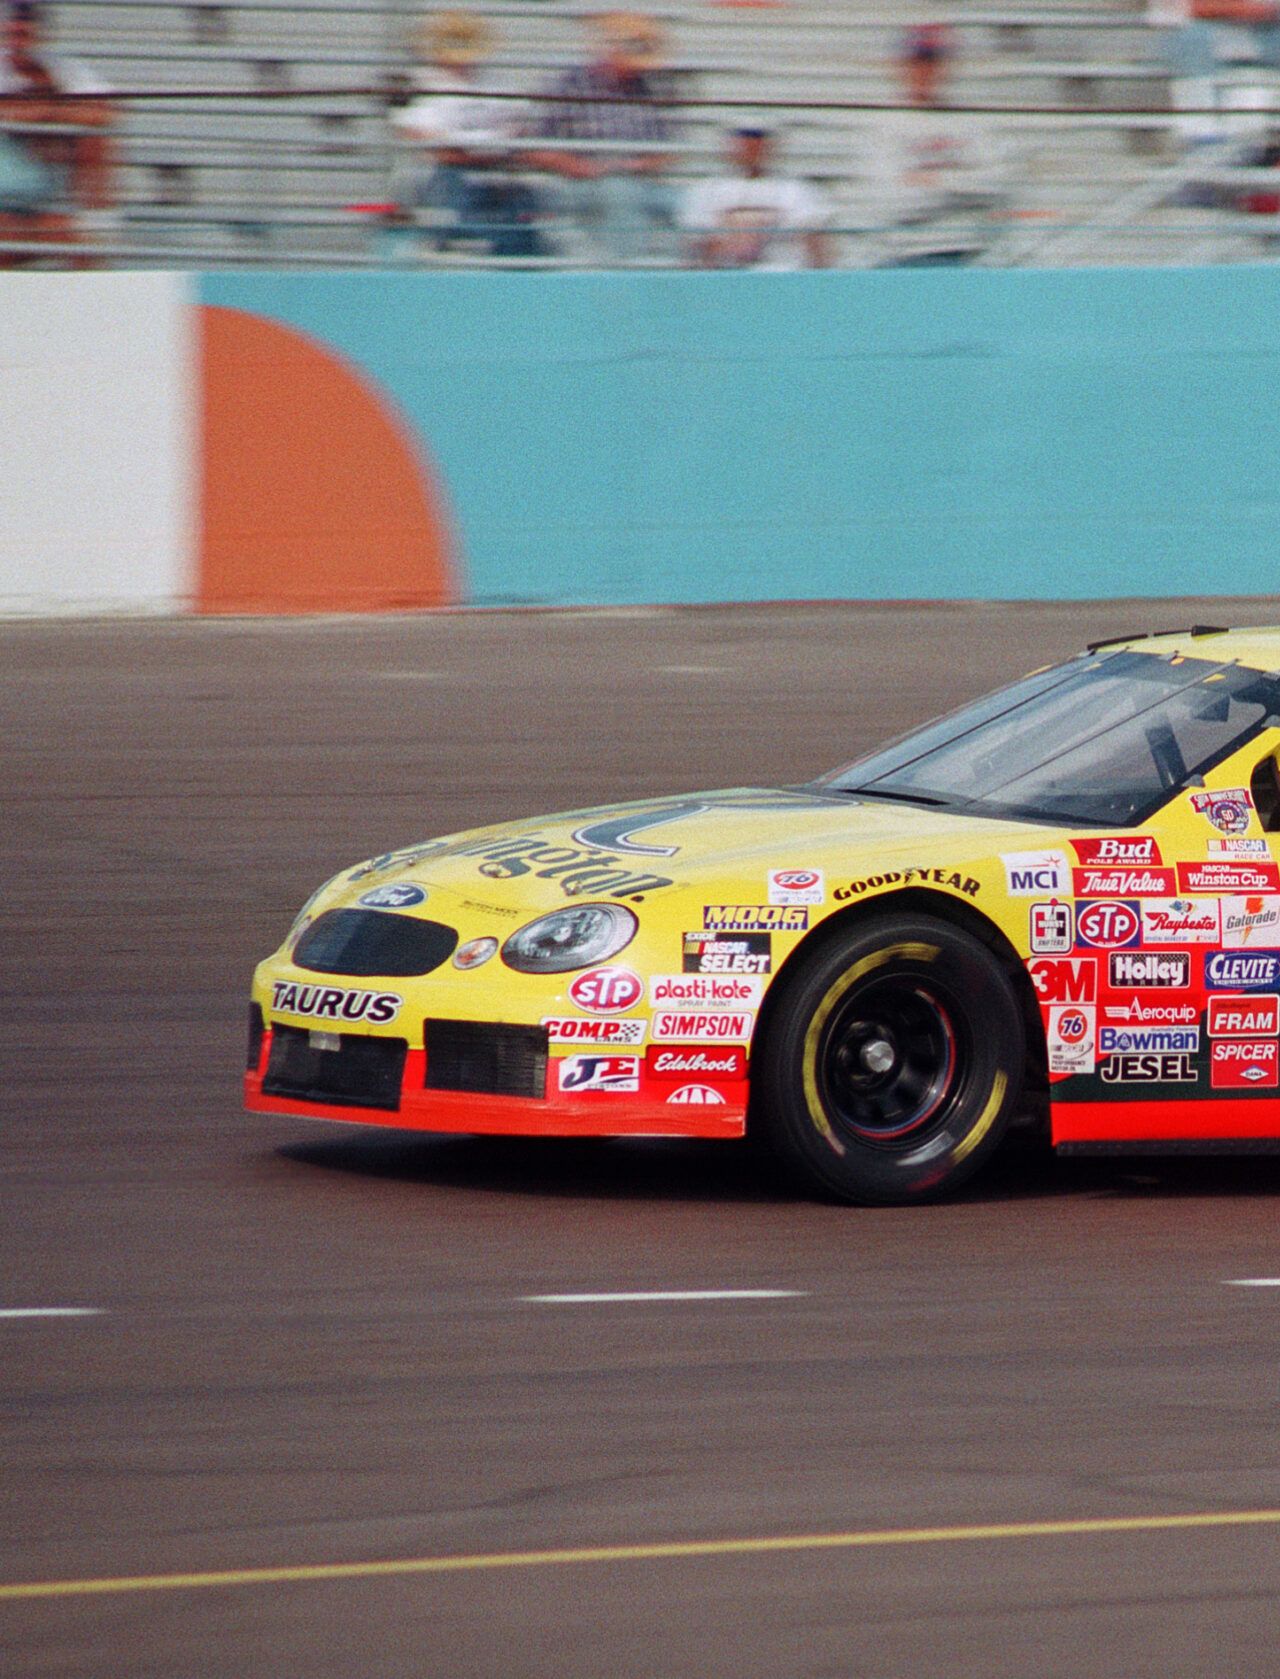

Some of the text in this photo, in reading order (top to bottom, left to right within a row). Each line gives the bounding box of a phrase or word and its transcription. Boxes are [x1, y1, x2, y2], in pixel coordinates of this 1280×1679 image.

[1097, 839, 1153, 858] Bud
[1226, 839, 1265, 852] NASCAR
[1201, 865, 1231, 873] NASCAR
[832, 868, 982, 898] GOODYEAR
[1010, 870, 1059, 890] MCI
[1187, 872, 1269, 887] Winston Cup
[705, 906, 807, 923] MOOG
[1085, 906, 1130, 939] STP
[1144, 911, 1217, 935] Raybestos
[1226, 910, 1277, 930] Gatorade
[703, 941, 749, 955] NASCAR
[698, 954, 771, 973] SELECT
[1115, 955, 1185, 987] Holley
[1209, 953, 1278, 979] CLEVITE
[575, 969, 634, 1008] STP
[654, 979, 752, 1001] plasti-kote
[1030, 960, 1096, 1002] 3M
[272, 981, 402, 1022] TAURUS
[1128, 996, 1196, 1023] Aeroquip
[544, 1020, 621, 1038] COMP
[659, 1015, 745, 1037] SIMPSON
[1062, 1017, 1083, 1035] 76
[1214, 1012, 1274, 1030] FRAM
[1100, 1027, 1198, 1051] Bowman
[653, 1052, 738, 1072] Edelbrock
[1213, 1044, 1276, 1060] SPICER
[1102, 1054, 1199, 1083] JESEL
